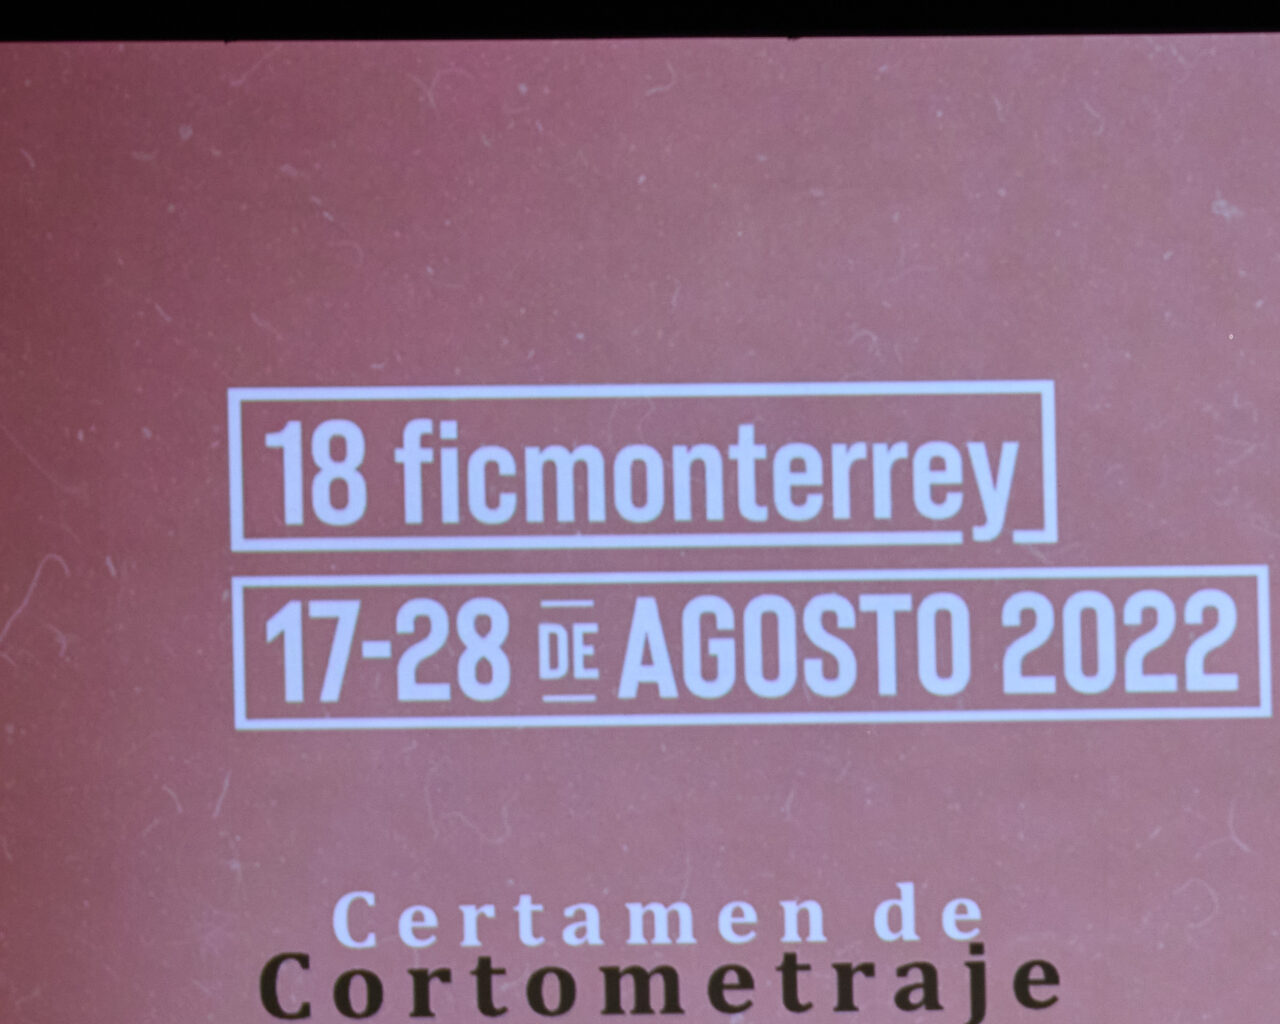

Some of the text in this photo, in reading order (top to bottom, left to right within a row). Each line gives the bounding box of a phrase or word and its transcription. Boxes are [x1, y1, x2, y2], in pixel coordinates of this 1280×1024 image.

[265, 419, 1019, 542] 18 ficmonterrey
[265, 588, 1240, 704] 17-28 DE AGOSTO 2022
[333, 882, 982, 949] Certamen de
